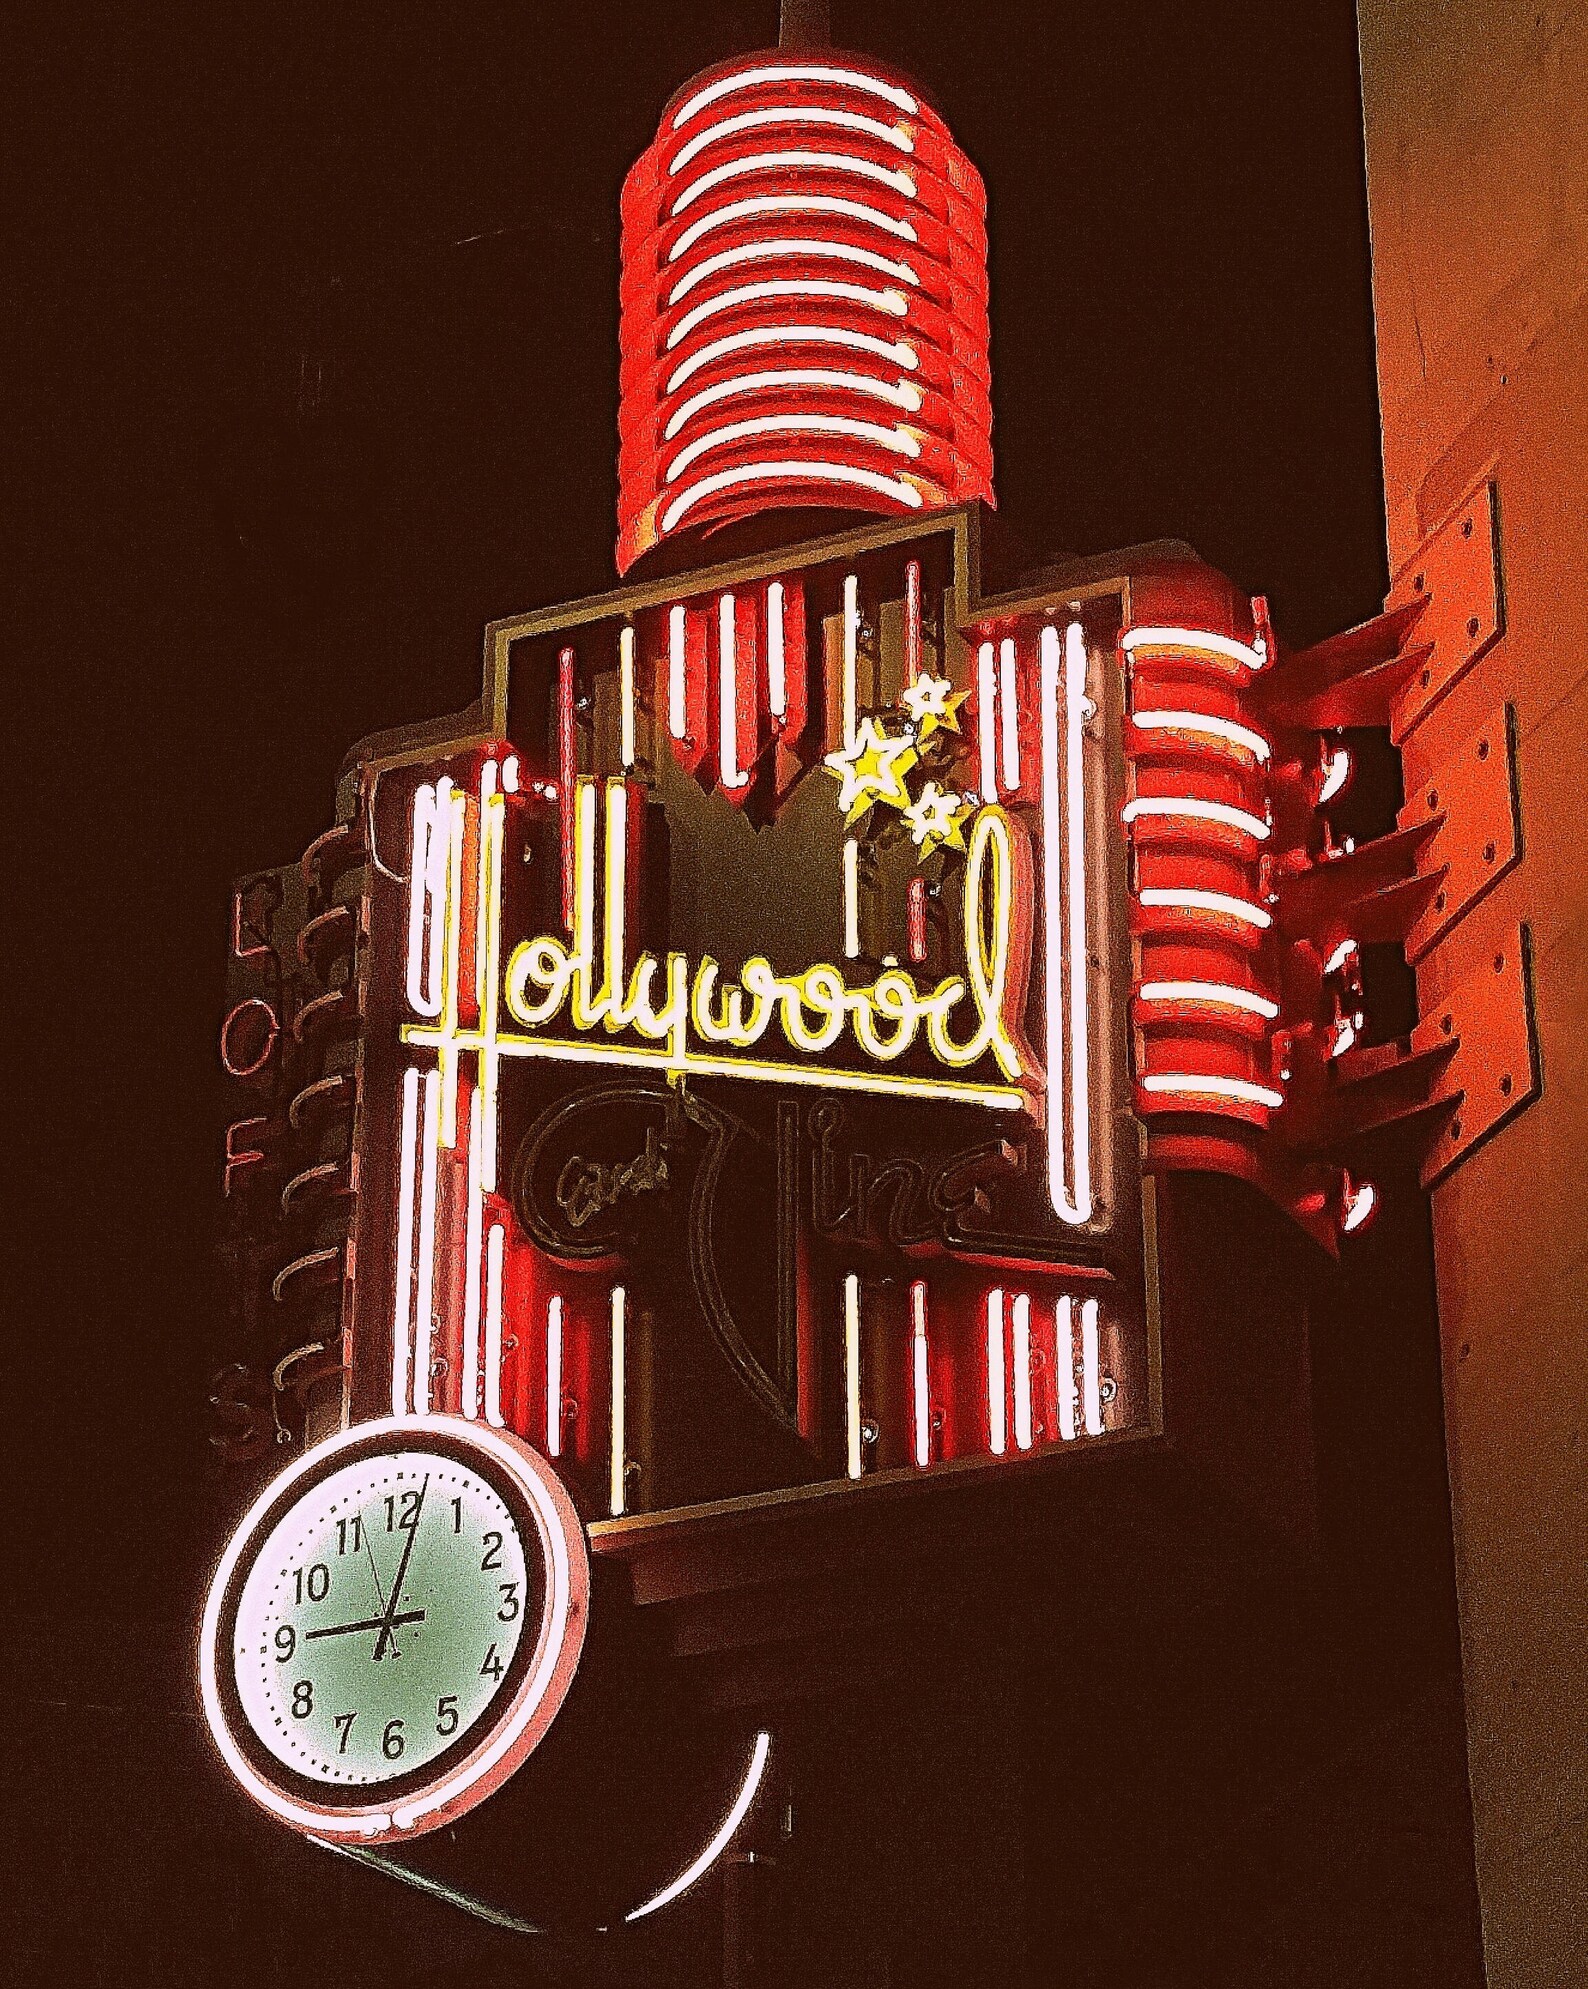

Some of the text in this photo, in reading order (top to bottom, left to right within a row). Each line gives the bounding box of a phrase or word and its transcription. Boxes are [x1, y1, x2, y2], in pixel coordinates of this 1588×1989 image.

[400, 775, 1026, 1193] Hollywood
[207, 880, 272, 1456] LOFS
[384, 1490, 423, 1533] 12
[451, 1496, 464, 1534] 1
[336, 1515, 362, 1556] 11
[480, 1531, 504, 1572] 2
[293, 1563, 330, 1605] 10
[498, 1582, 520, 1622] 3
[274, 1625, 296, 1663] 9
[480, 1643, 504, 1683] 4
[291, 1679, 314, 1720] 8
[436, 1695, 459, 1737] 5
[333, 1712, 358, 1755] 7
[382, 1719, 405, 1760] 6
